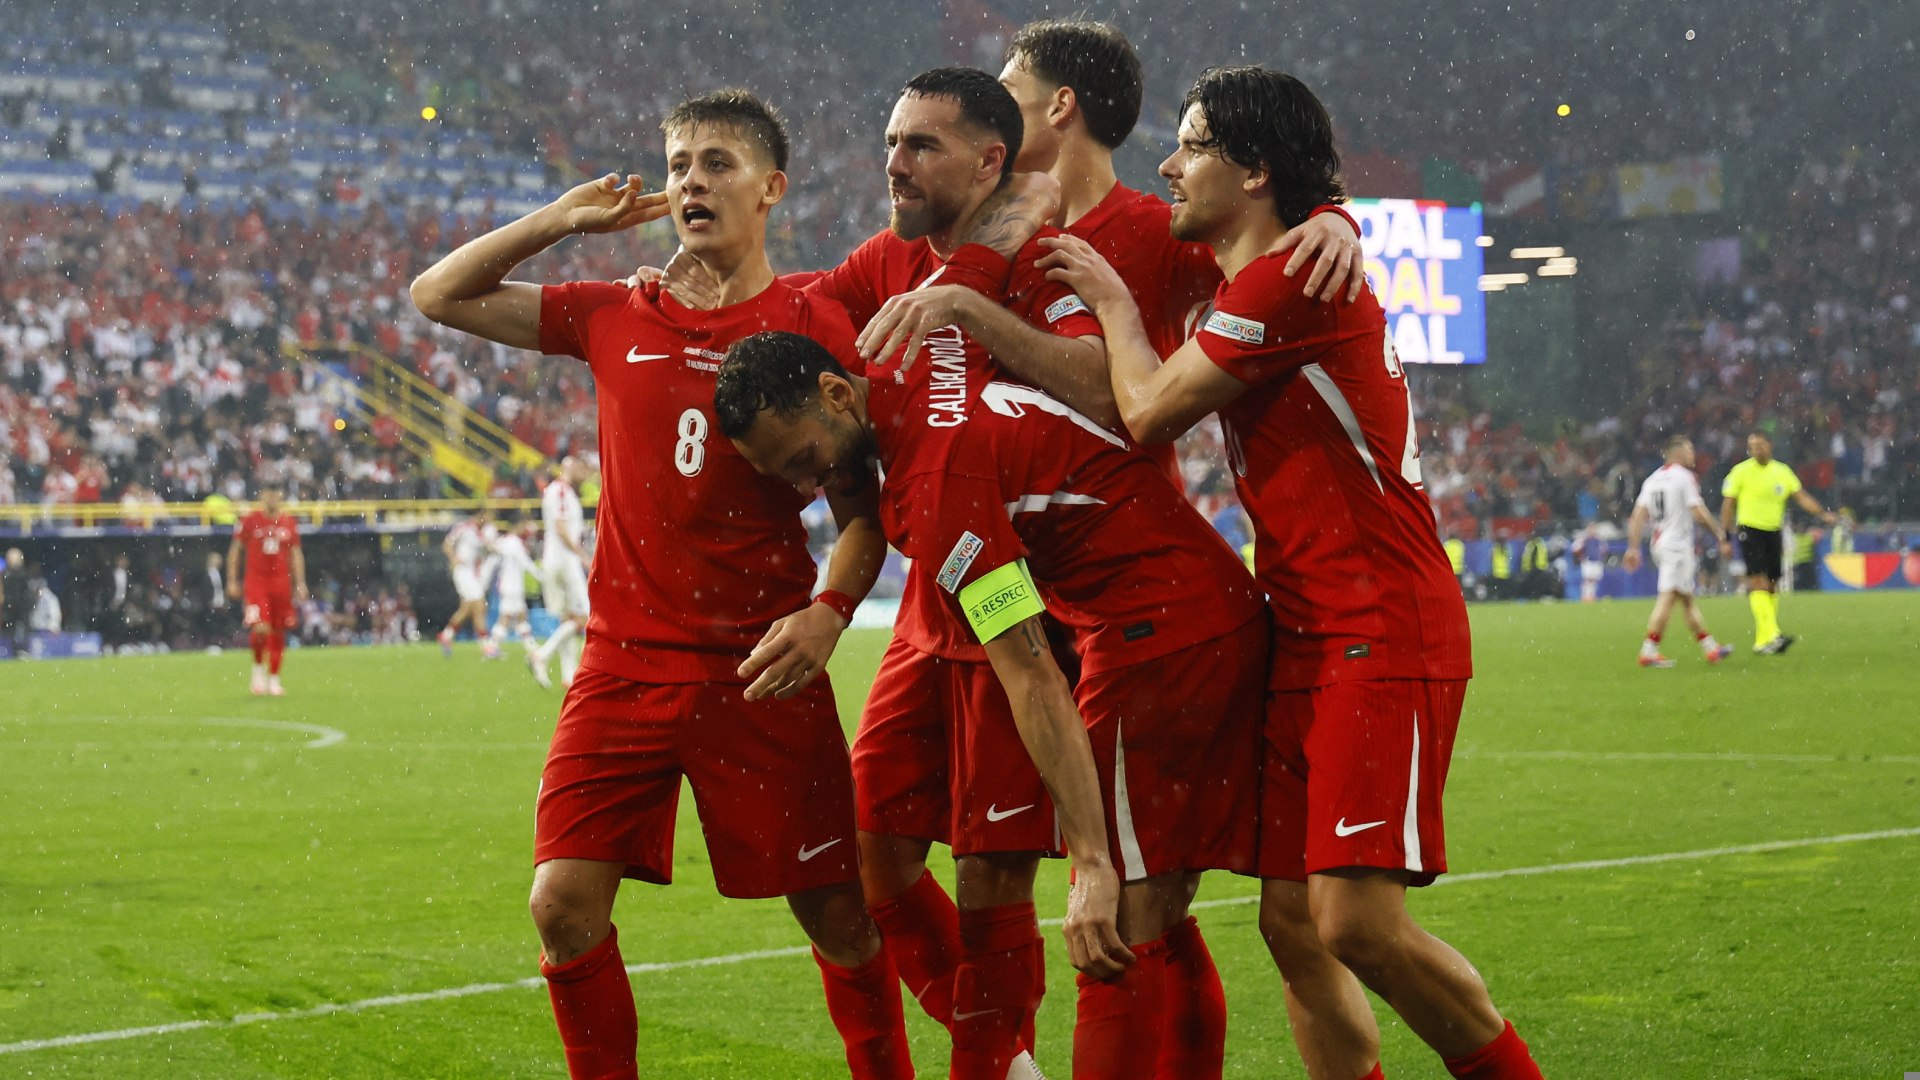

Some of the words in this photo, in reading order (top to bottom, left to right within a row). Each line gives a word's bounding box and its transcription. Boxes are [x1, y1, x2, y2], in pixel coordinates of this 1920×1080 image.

[1346, 199, 1461, 260] OAL
[1363, 257, 1461, 315] OAL
[1393, 313, 1465, 364] AL
[675, 408, 708, 477] 8
[981, 583, 1026, 616] RESPECT
